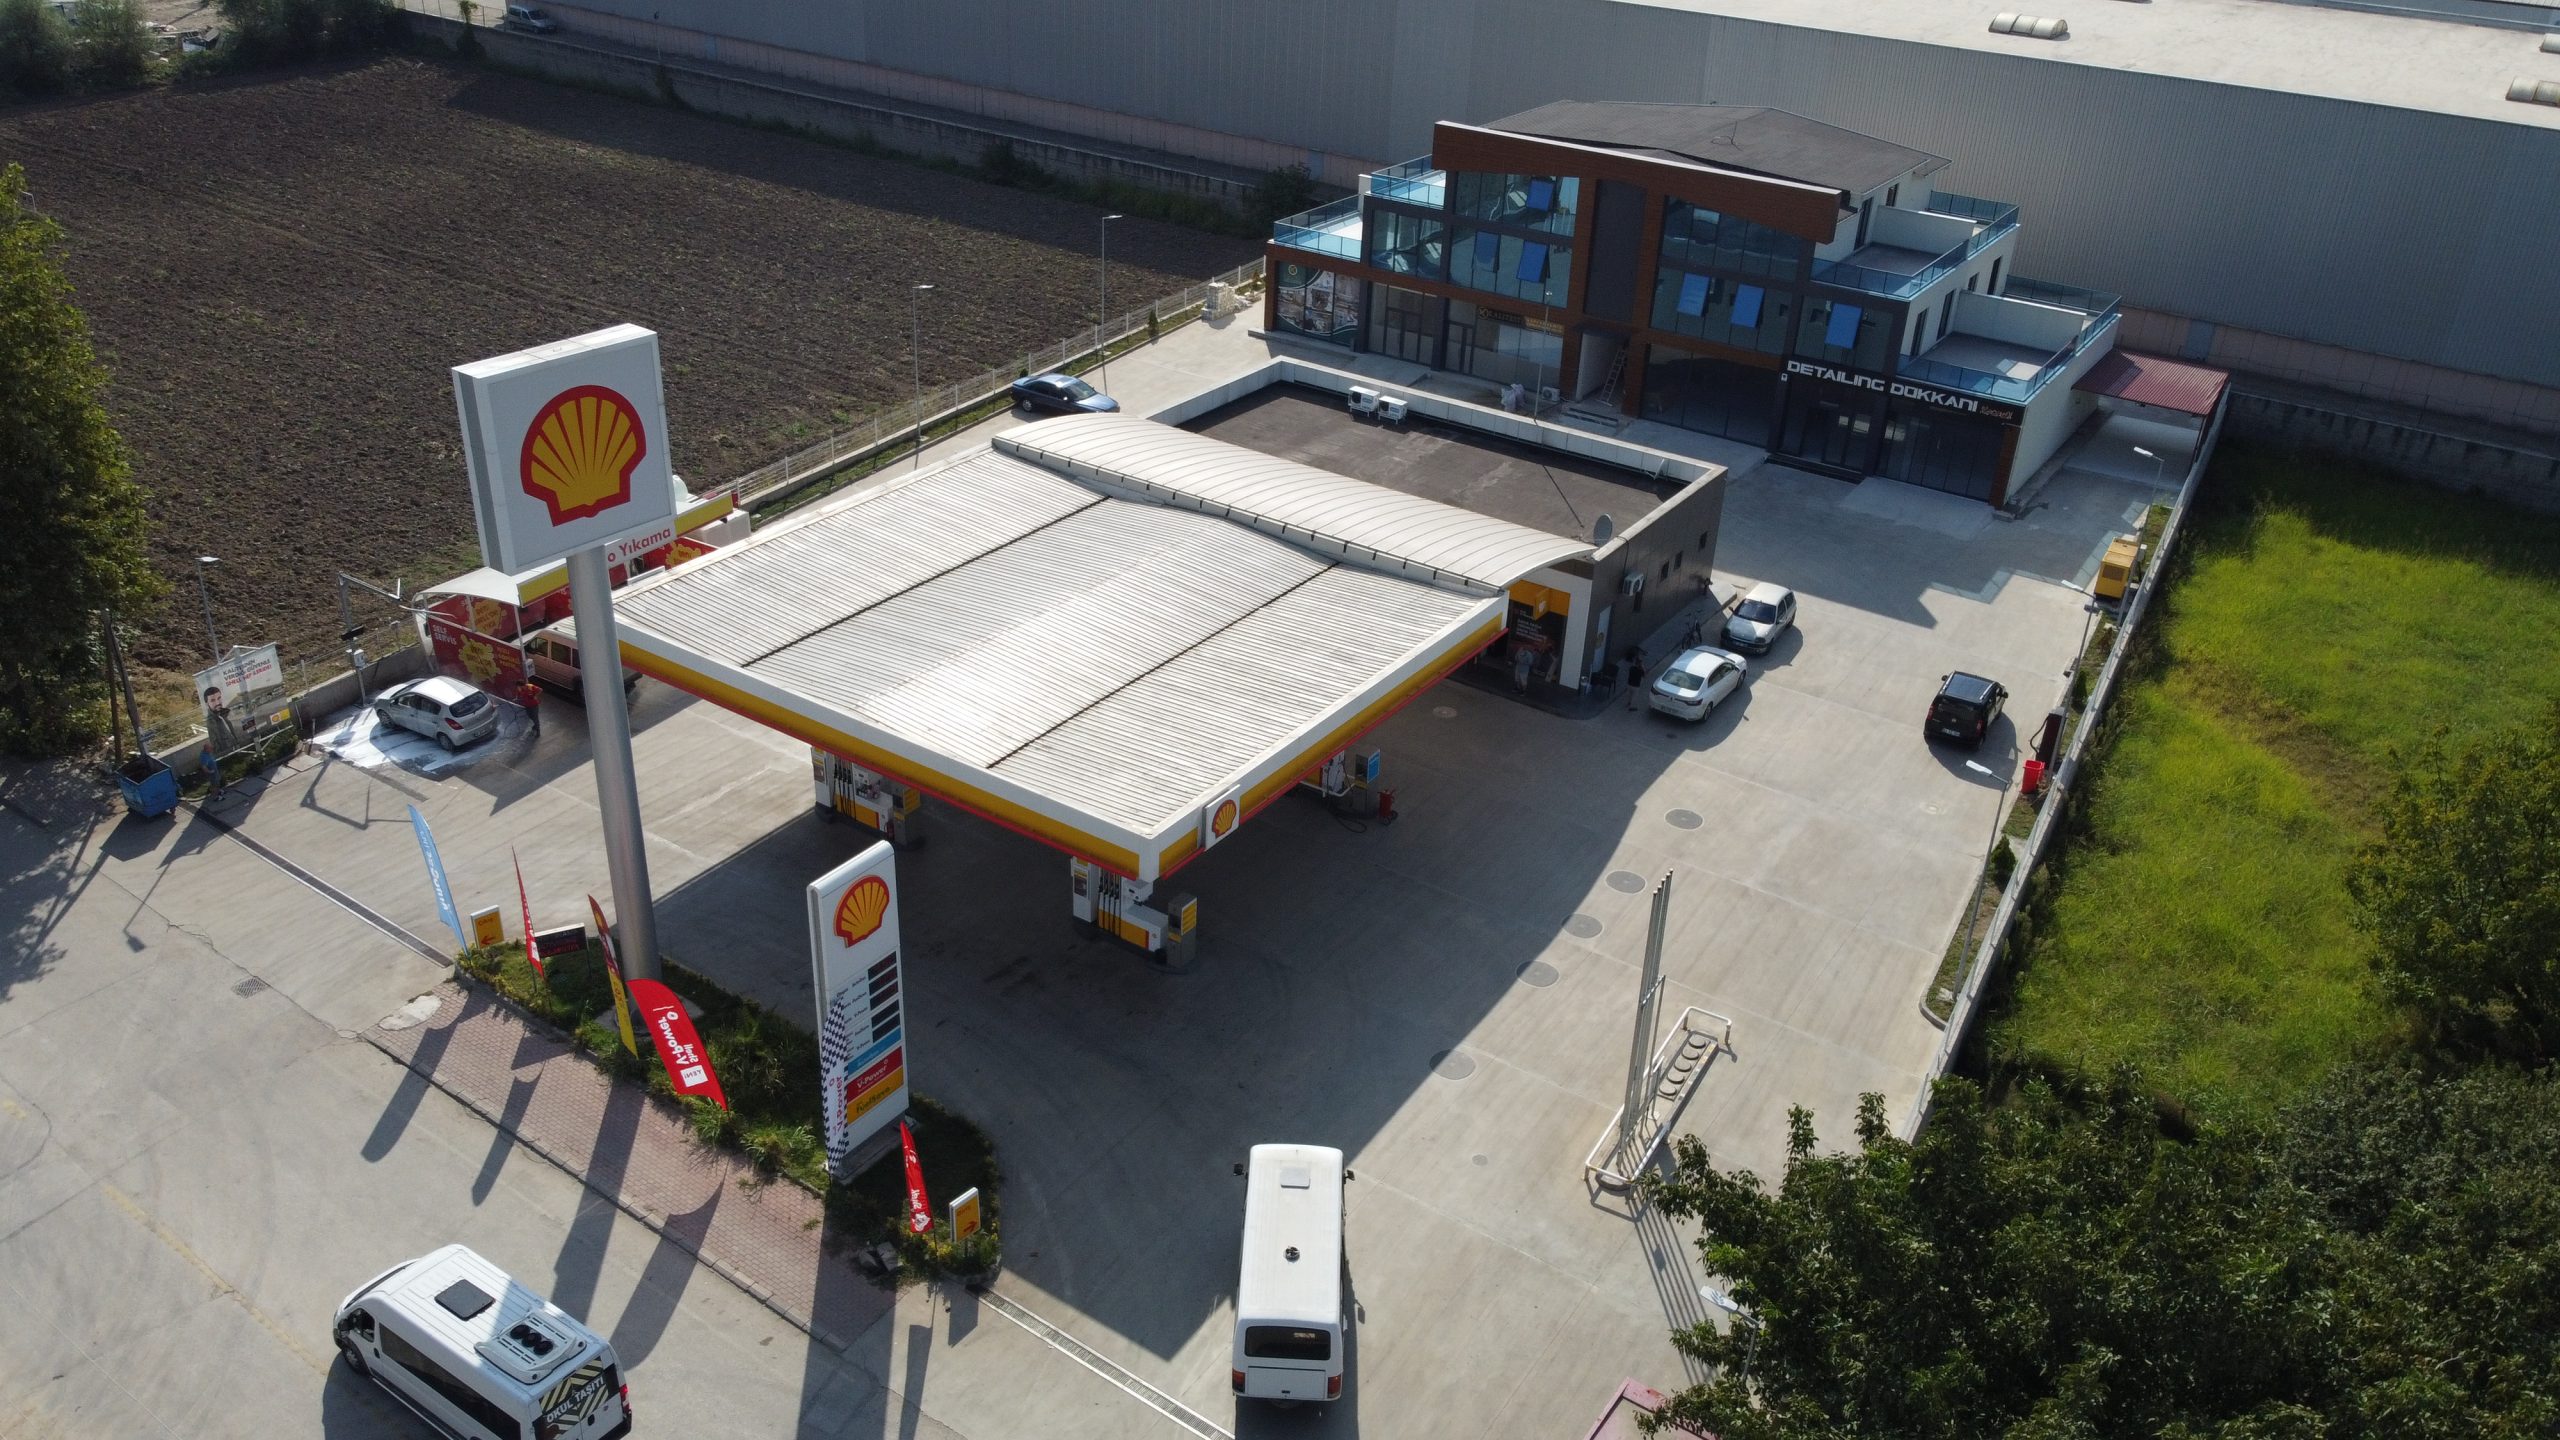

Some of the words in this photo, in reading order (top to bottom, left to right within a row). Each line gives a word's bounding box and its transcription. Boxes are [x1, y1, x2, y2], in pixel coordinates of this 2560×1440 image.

[1787, 360, 1885, 392] DETAILING
[619, 527, 671, 557] Yıkama
[857, 1064, 888, 1088] V-Power
[546, 1400, 574, 1423] OKUL
[574, 1376, 604, 1402] TAŞITI
